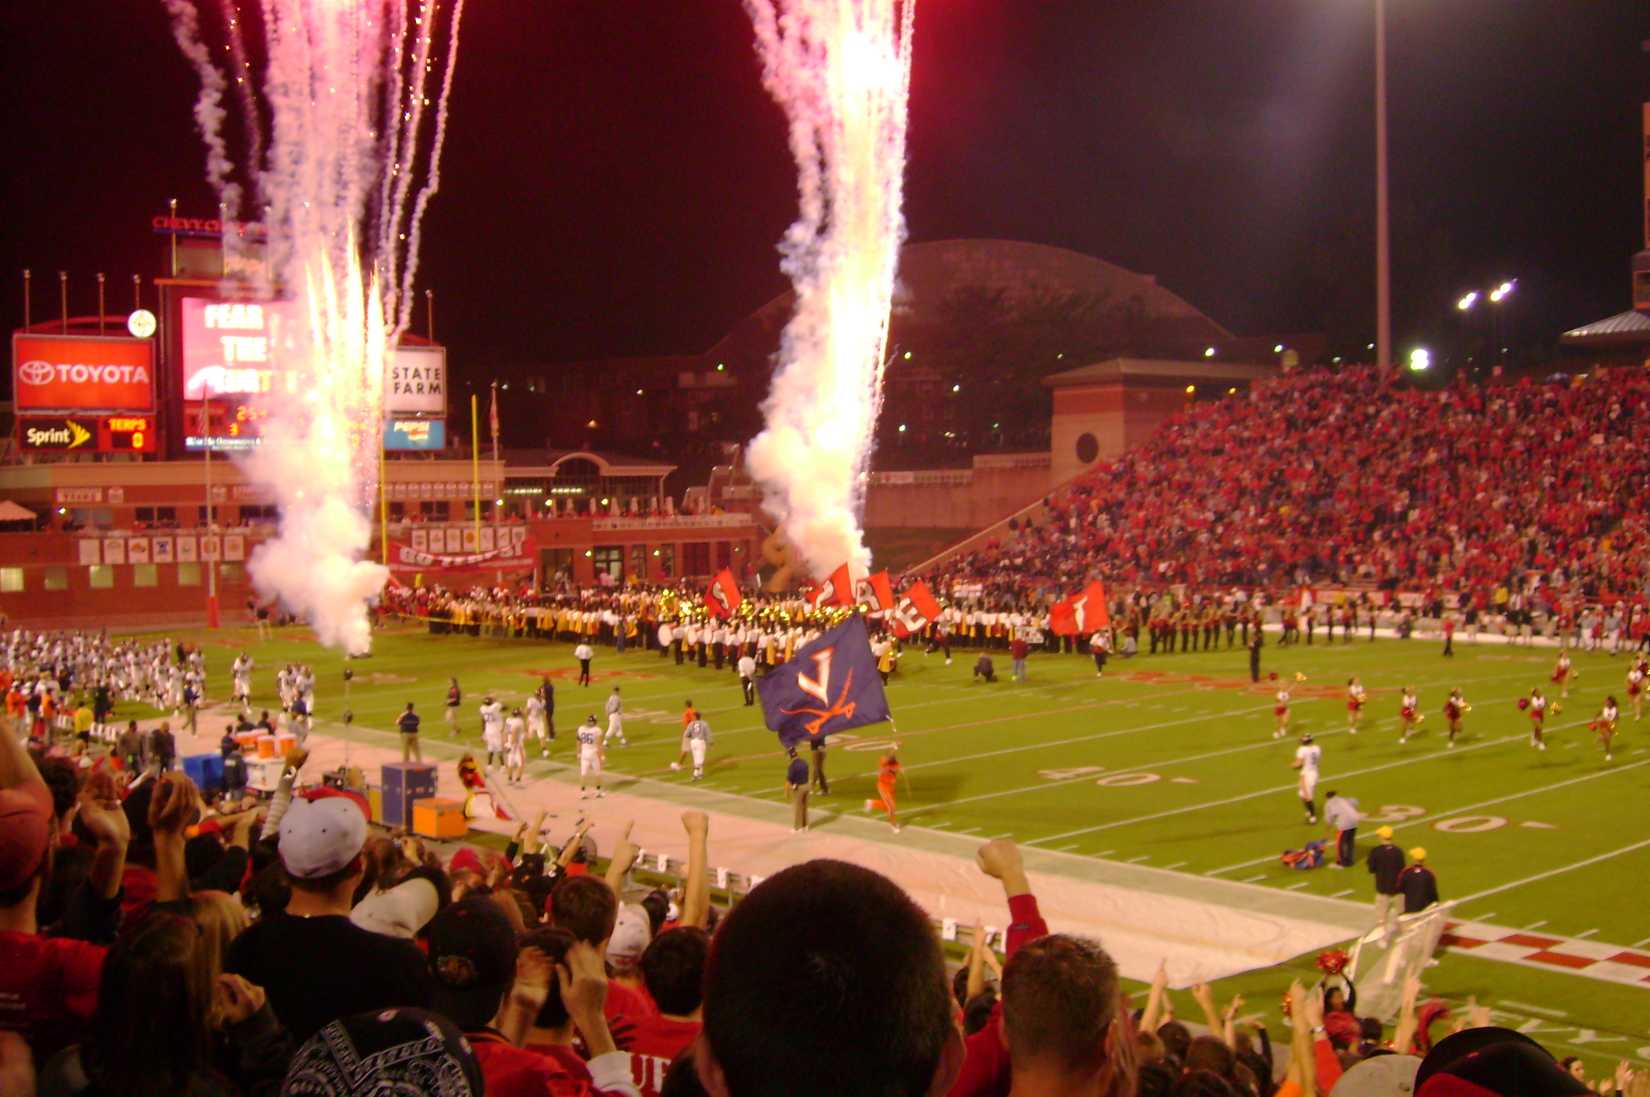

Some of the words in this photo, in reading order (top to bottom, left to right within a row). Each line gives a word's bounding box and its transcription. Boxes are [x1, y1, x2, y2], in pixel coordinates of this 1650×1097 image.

[56, 364, 149, 384] TOYOTA
[392, 366, 441, 380] STATE
[394, 382, 441, 394] FARM
[27, 428, 70, 446] Sprint
[797, 646, 835, 706] V
